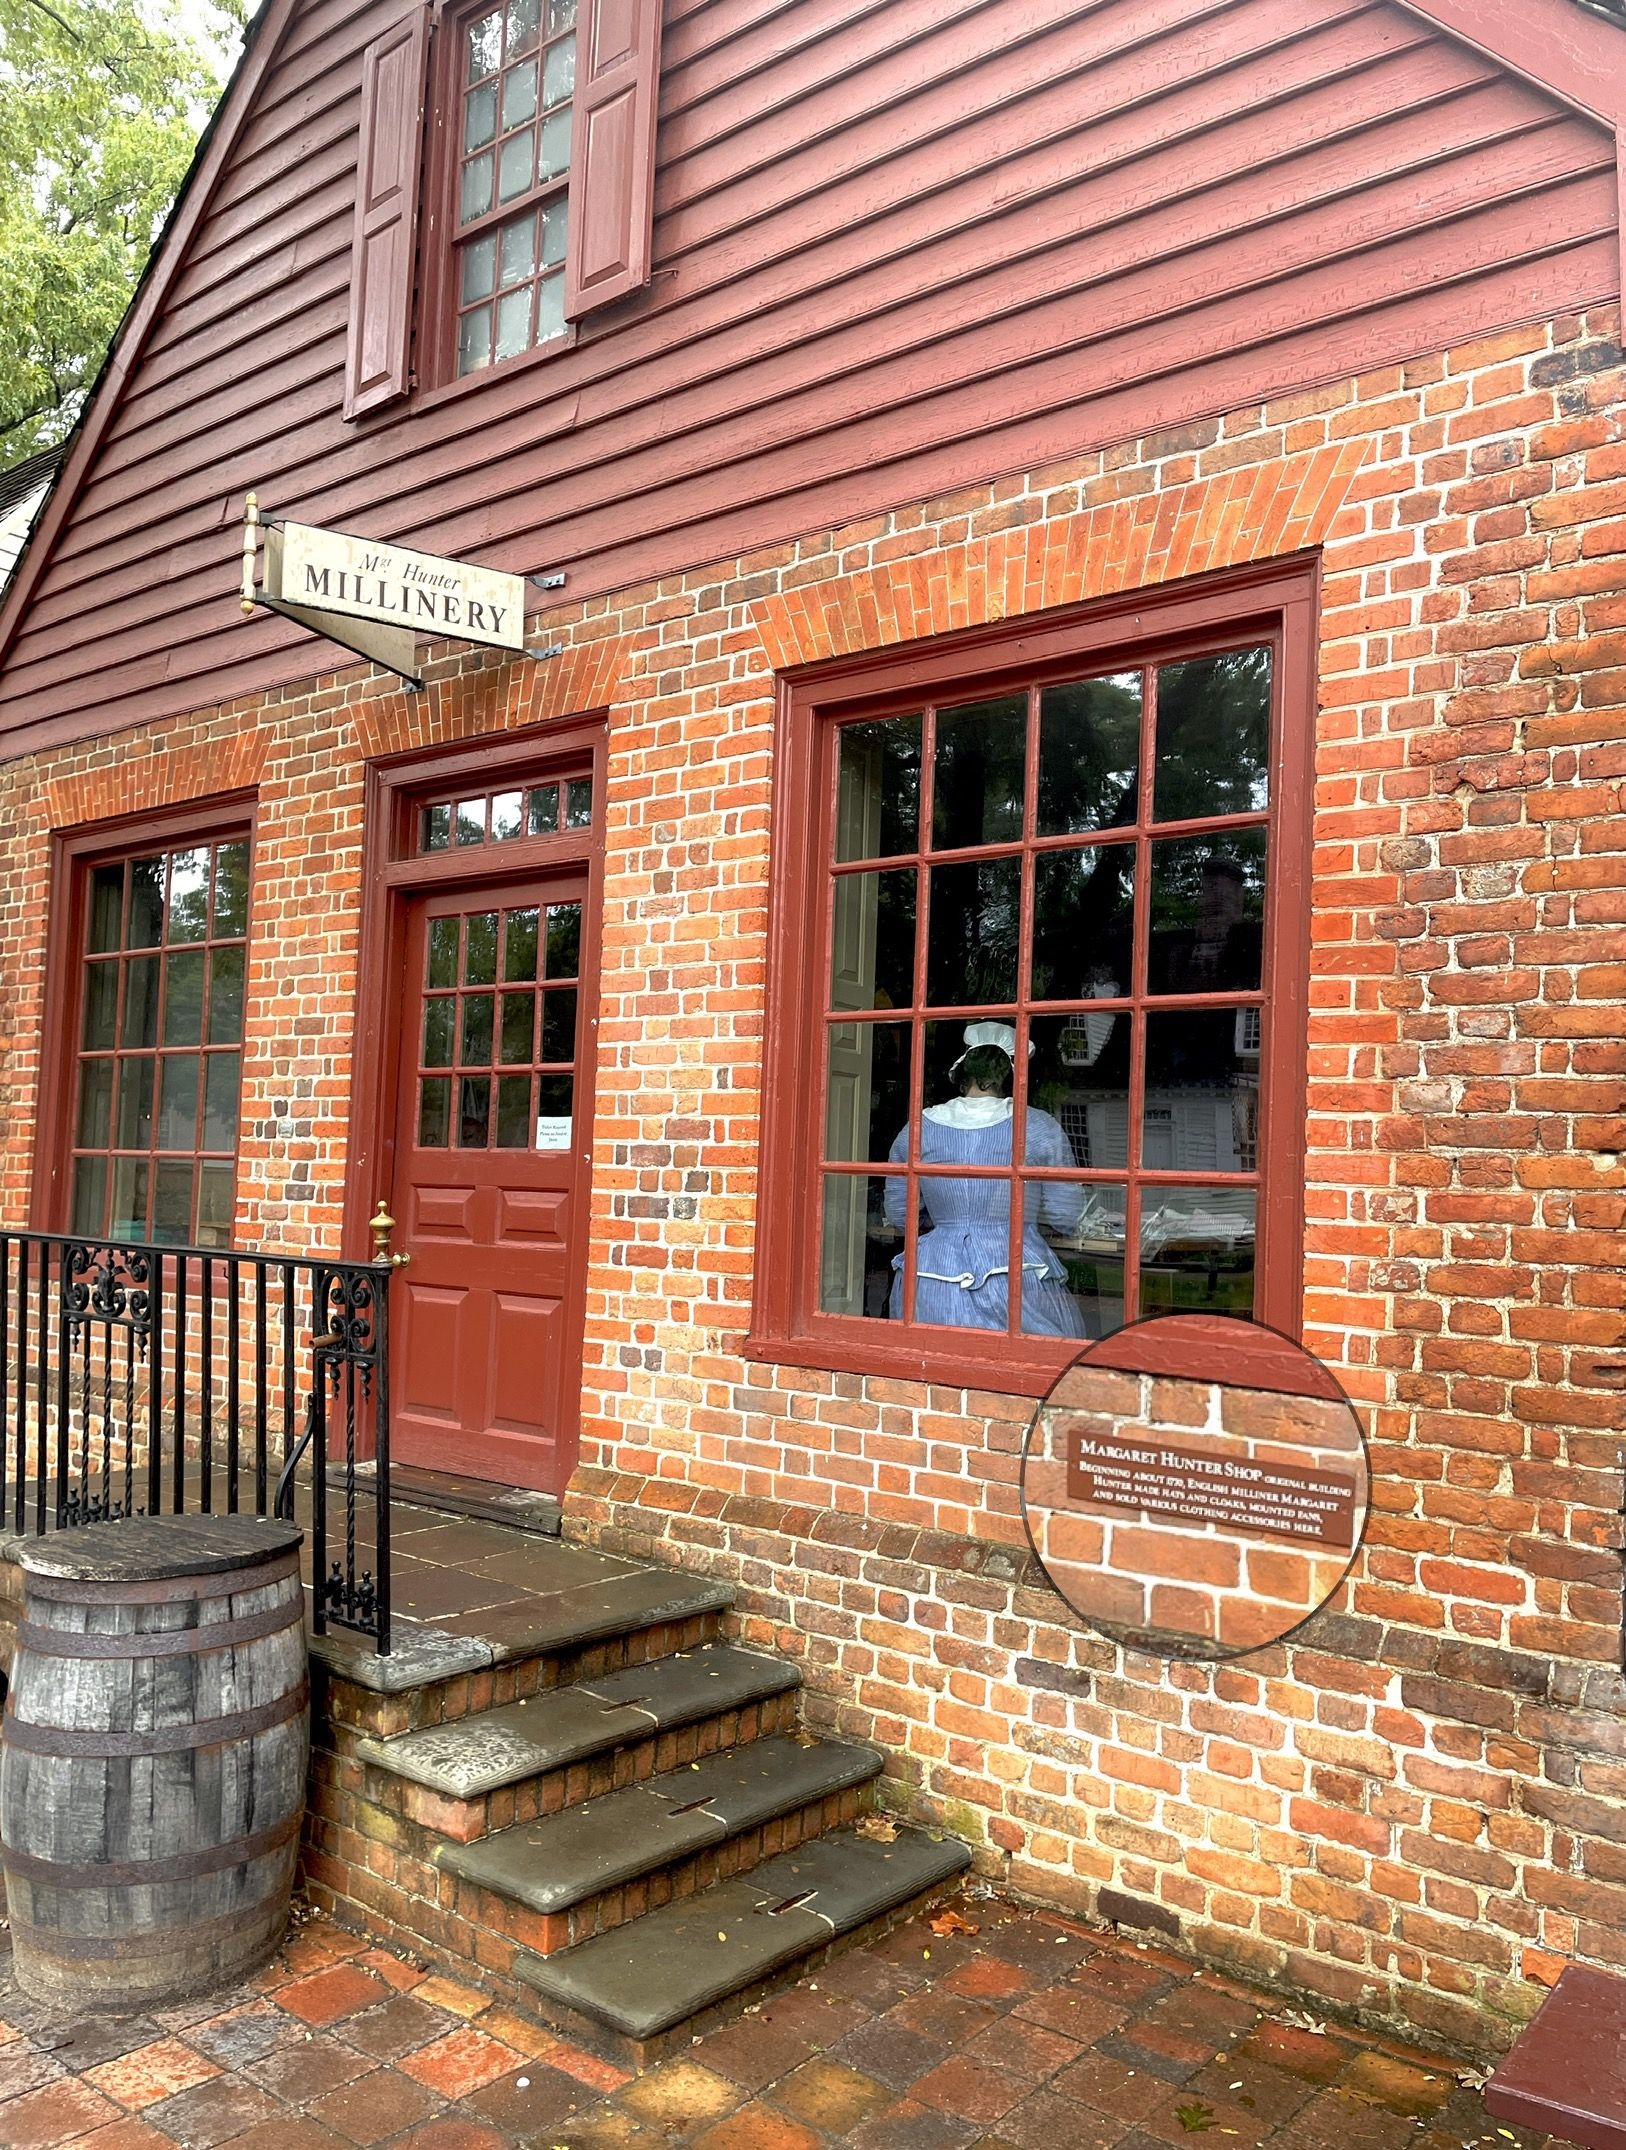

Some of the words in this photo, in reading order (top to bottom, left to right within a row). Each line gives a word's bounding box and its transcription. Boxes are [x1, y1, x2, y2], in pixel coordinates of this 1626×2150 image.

[304, 563, 507, 633] MILLINERY
[402, 563, 461, 590] Hunter
[1079, 1461, 1131, 1478] BEGINNING
[1132, 1472, 1165, 1484] ABOUT
[1187, 1478, 1229, 1494] ENGLISH
[1231, 1486, 1279, 1502] MILLINER
[1280, 1493, 1339, 1511] MARGARET
[1080, 1439, 1157, 1465] MARGARET
[1160, 1451, 1223, 1476] HUNTER
[1224, 1462, 1263, 1481] SHOP
[1264, 1475, 1306, 1489] ORIGINAL
[1308, 1482, 1352, 1497] BUILDING
[1092, 1490, 1113, 1500] AND
[1115, 1493, 1138, 1504] SOLD
[1140, 1497, 1177, 1510] VARIOUS
[1180, 1504, 1229, 1520] CLOTHING
[1230, 1512, 1291, 1529] ACCESSORIES
[1093, 1474, 1132, 1491] HUNTER
[1134, 1483, 1160, 1495] MADE
[1162, 1487, 1185, 1499] HATS
[1188, 1493, 1208, 1503] AND
[1249, 1502, 1296, 1518] MOUNTED
